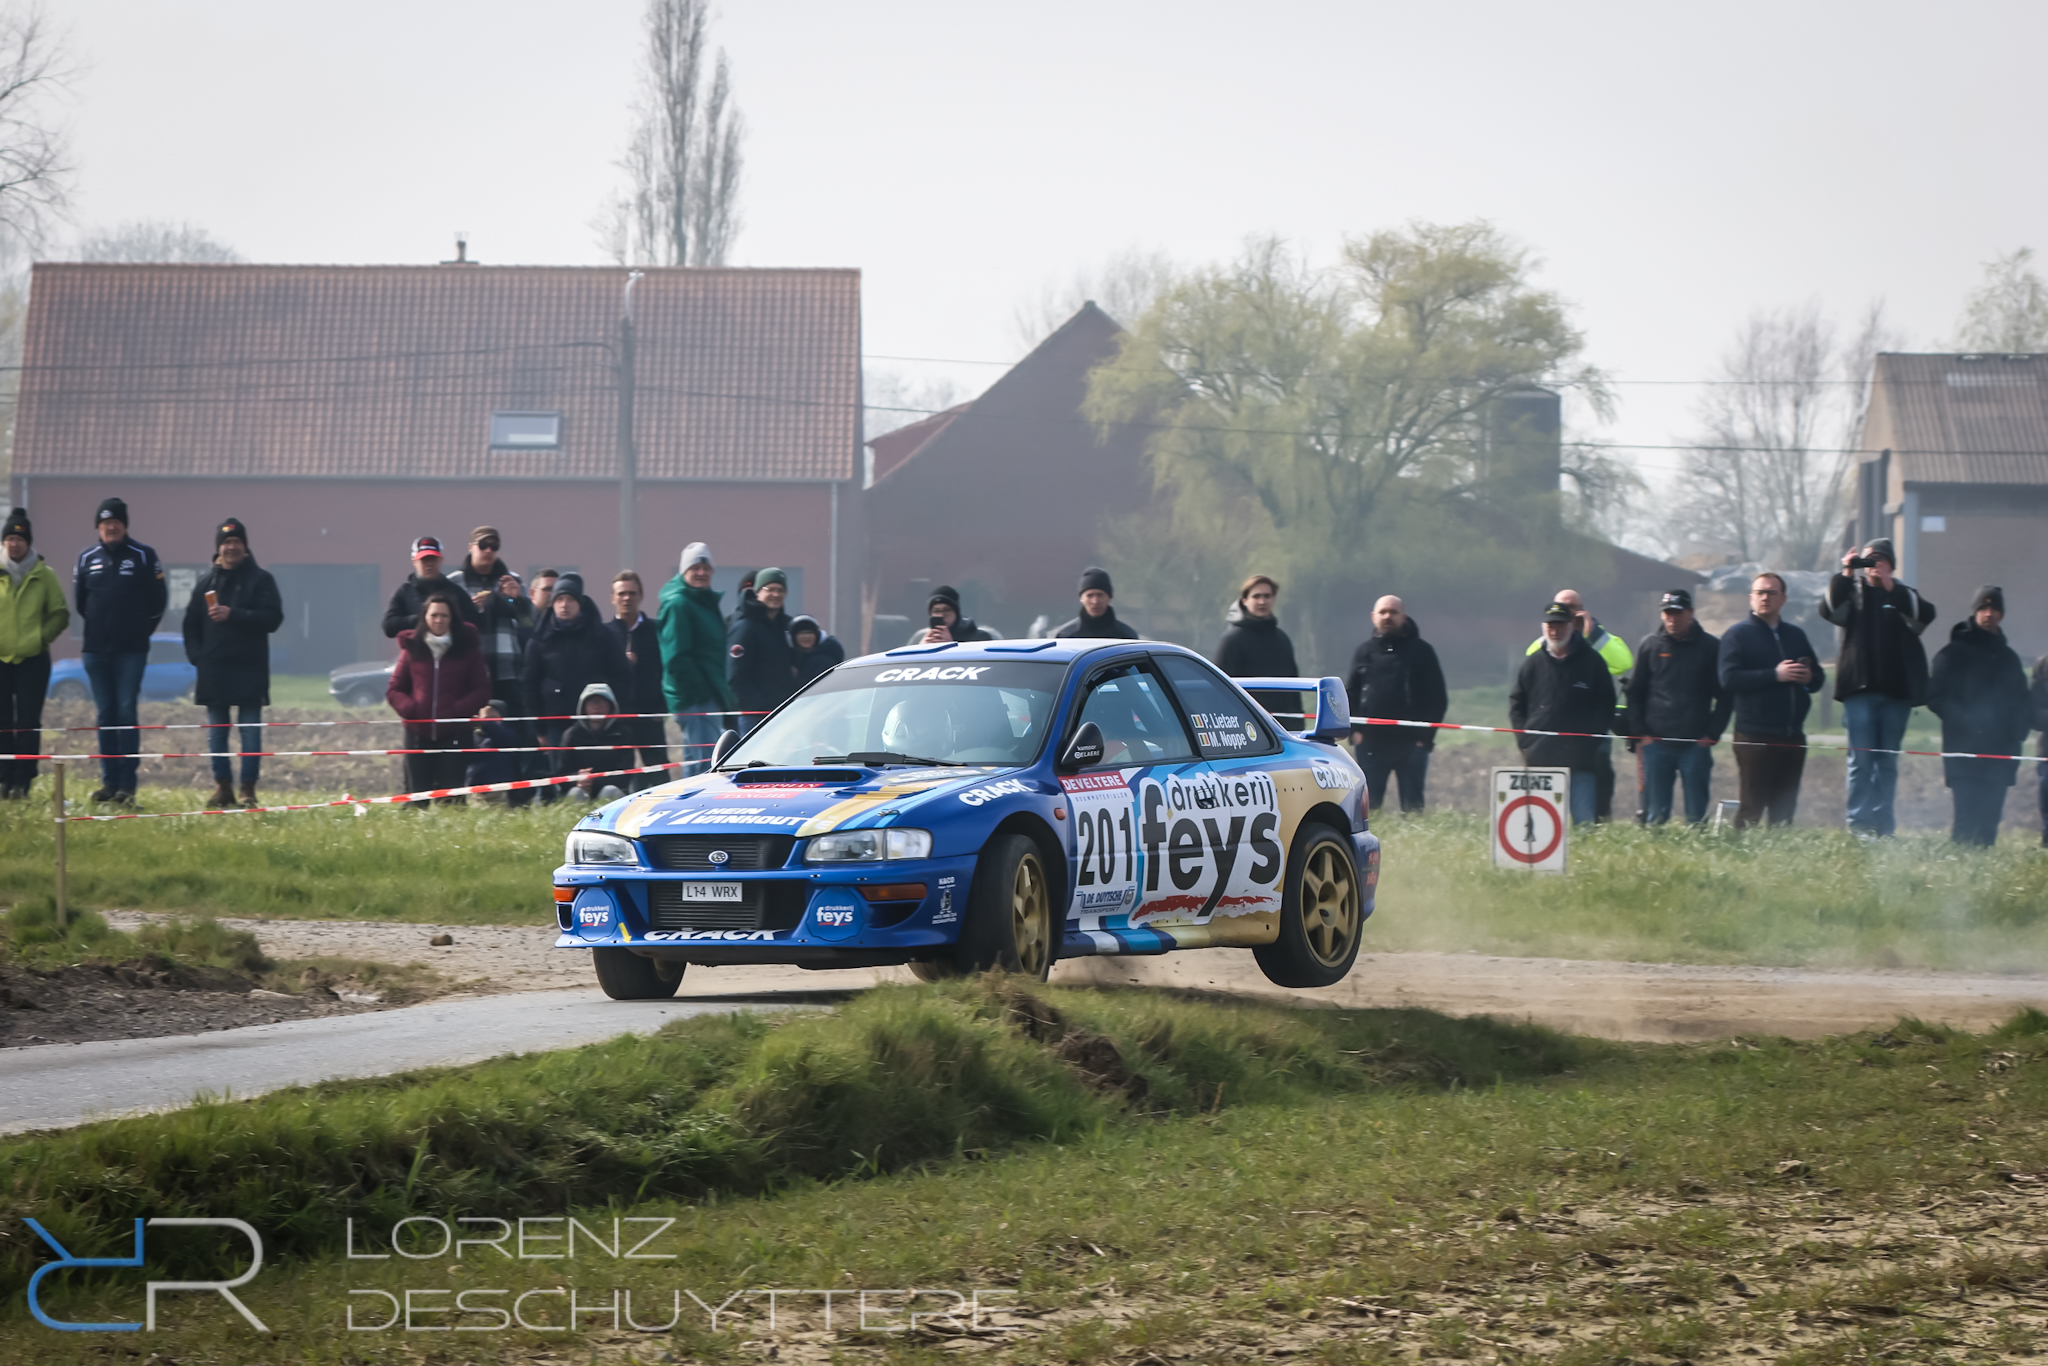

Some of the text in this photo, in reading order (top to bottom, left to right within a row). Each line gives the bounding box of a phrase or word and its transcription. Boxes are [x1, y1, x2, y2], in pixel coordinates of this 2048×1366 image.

[874, 667, 991, 682] CRACK
[1201, 713, 1240, 729] P. Lietaer
[1208, 731, 1247, 749] M. Noppe
[1061, 775, 1124, 791] DEVELTERE
[1312, 766, 1355, 789] CRACK
[1509, 775, 1553, 791] ZONE
[958, 778, 1034, 807] CRACK
[1171, 776, 1275, 812] drukkerij
[706, 807, 767, 815] HEIN
[691, 816, 835, 831] VANHOUTTE
[1078, 807, 1133, 886] 201
[1142, 784, 1281, 917] feys
[712, 886, 738, 898] WRX
[579, 907, 609, 926] feys
[816, 907, 853, 926] feys
[1080, 907, 1120, 915] TRANSPORT
[643, 929, 788, 941] CRACK
